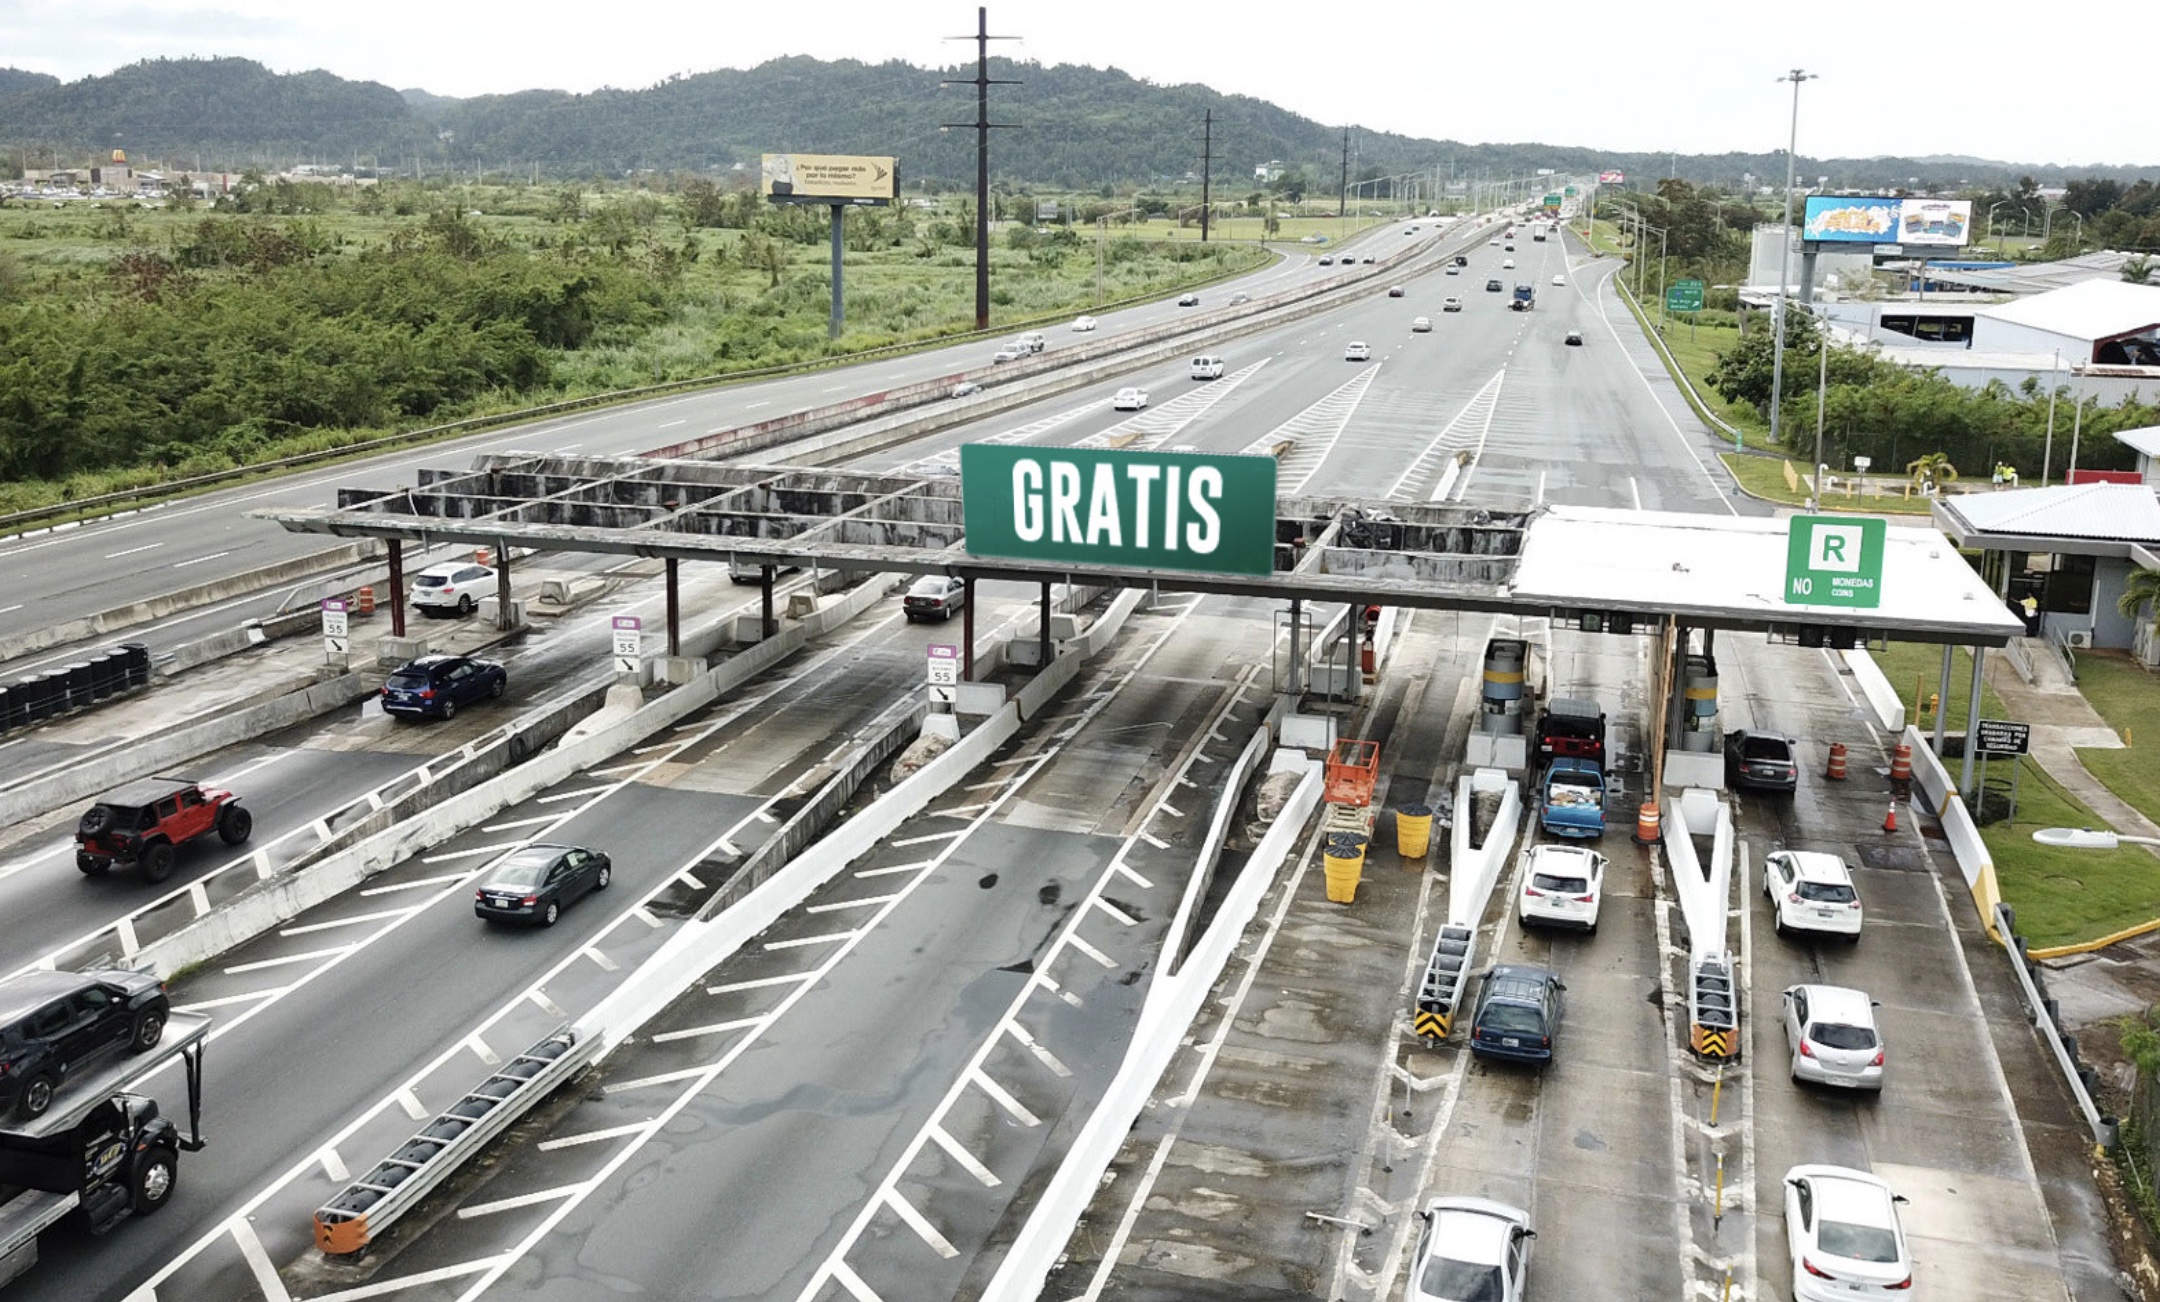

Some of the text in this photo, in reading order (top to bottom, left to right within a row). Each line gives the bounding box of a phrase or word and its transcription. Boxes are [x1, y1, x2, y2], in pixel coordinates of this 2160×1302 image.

[1823, 534, 1846, 562] R
[1792, 577, 1874, 595] NO MONEDAS
[329, 624, 343, 634] 55
[619, 643, 635, 653] 55
[934, 672, 950, 682] 55
